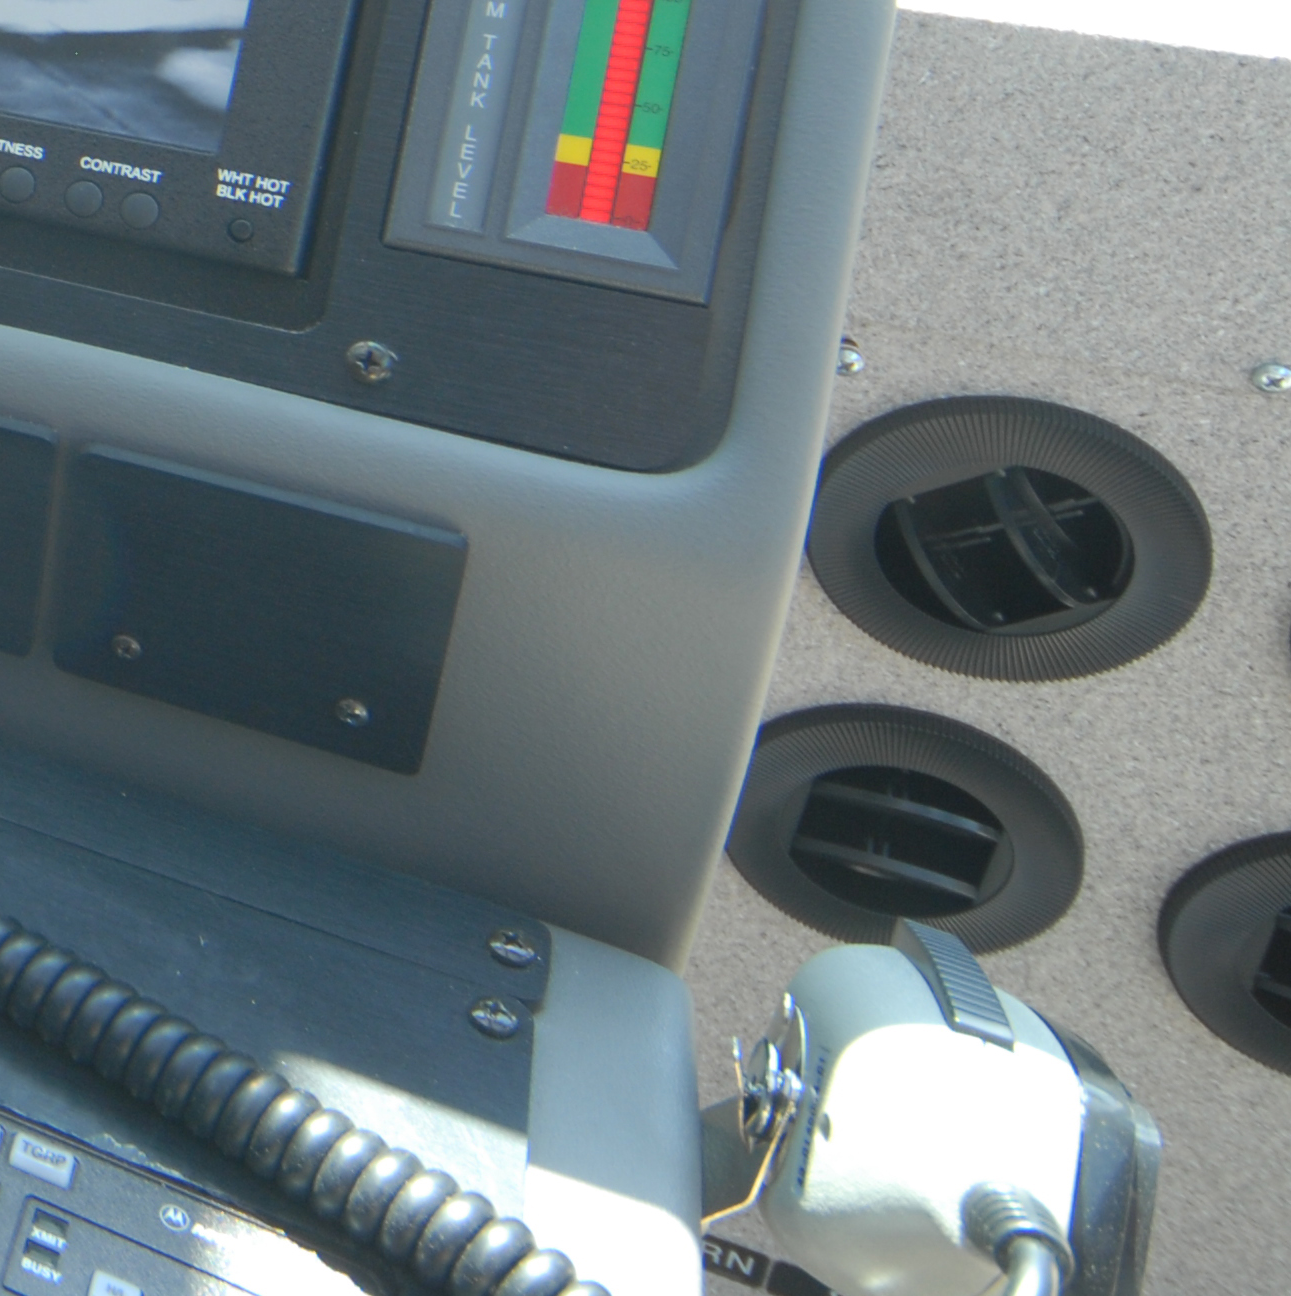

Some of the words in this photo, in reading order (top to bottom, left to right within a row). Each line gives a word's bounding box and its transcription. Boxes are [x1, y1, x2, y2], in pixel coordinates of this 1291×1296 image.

[652, 44, 670, 58] 75
[470, 33, 498, 109] TANK
[641, 102, 659, 115] 50
[79, 156, 162, 184] CONTRAST
[449, 125, 477, 218] LEVEL
[630, 159, 649, 172] 25
[217, 168, 254, 186] WHT
[255, 175, 291, 194] HOT
[216, 184, 247, 202] BLK
[249, 190, 284, 209] HOT
[21, 1139, 68, 1168] TGRP
[29, 1225, 68, 1251] XMIT
[21, 1255, 65, 1285] BUSY
